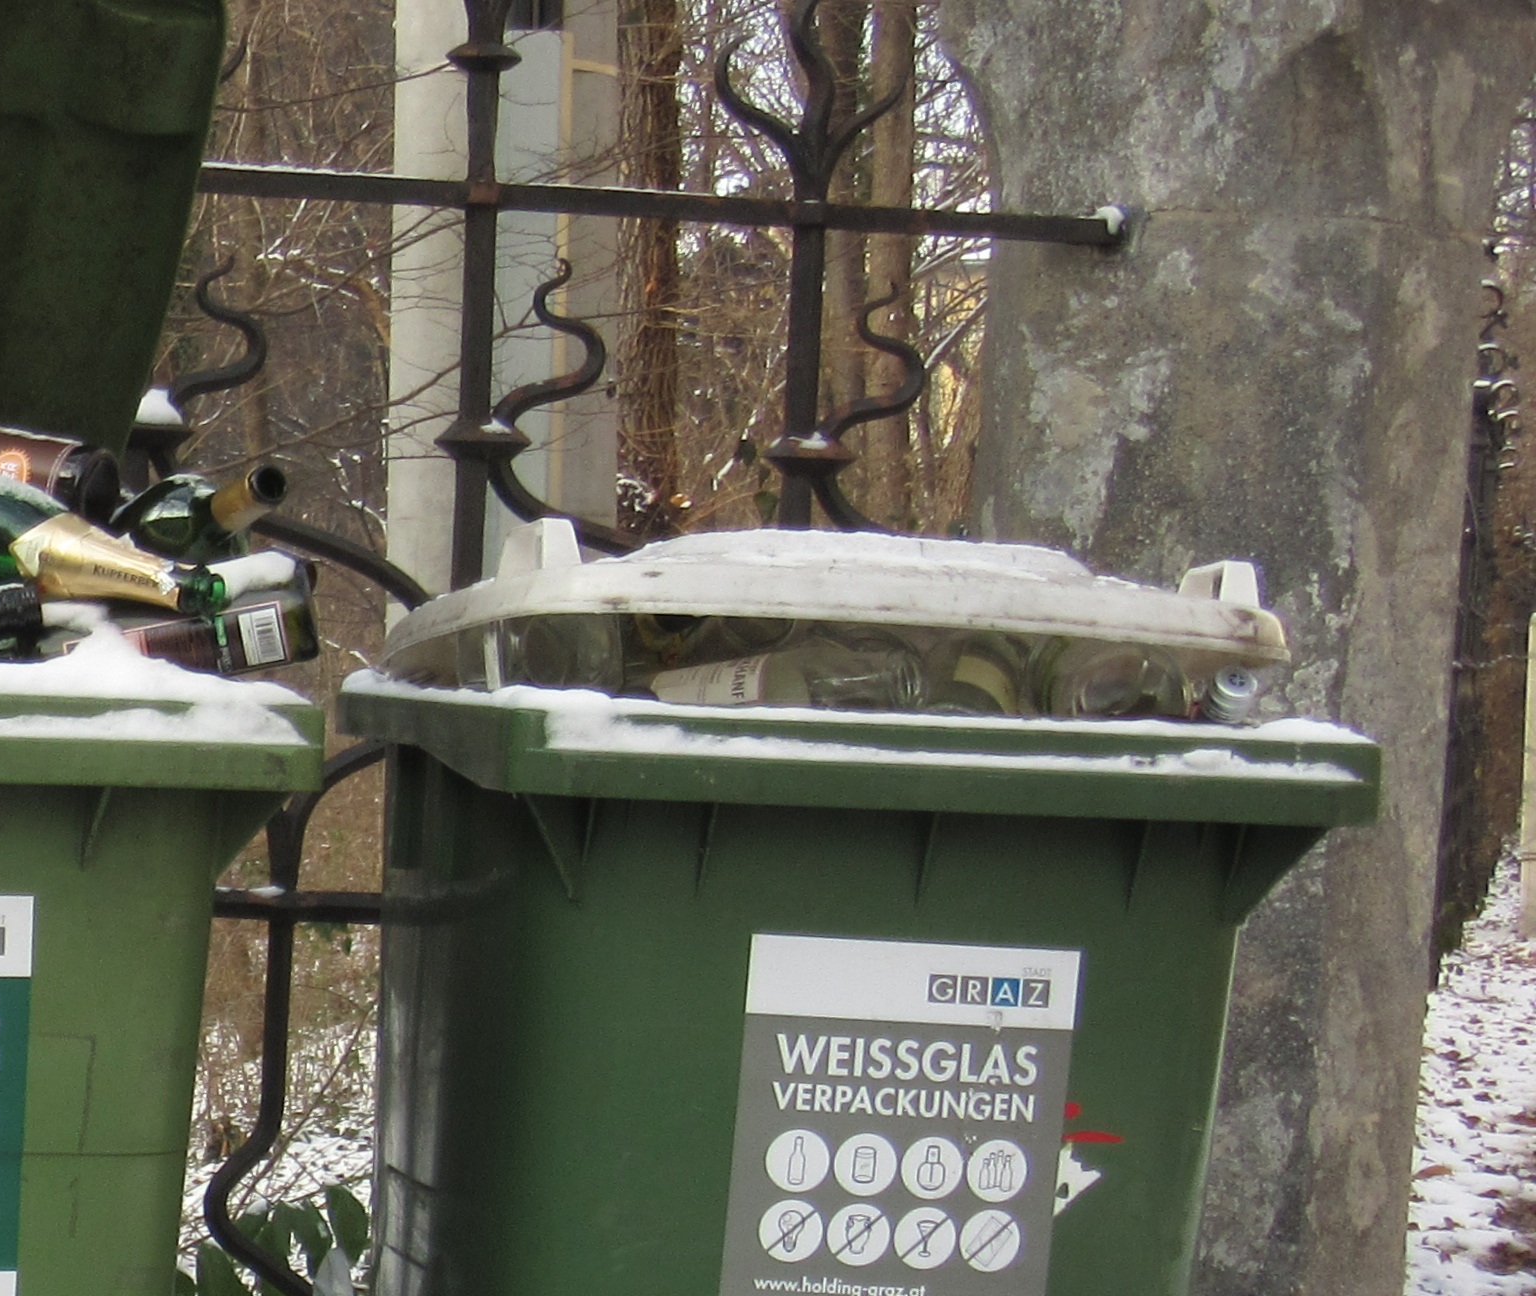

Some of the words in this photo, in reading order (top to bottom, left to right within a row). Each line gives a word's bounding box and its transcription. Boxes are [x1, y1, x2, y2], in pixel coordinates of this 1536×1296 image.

[1022, 967, 1051, 977] STADT
[929, 975, 1049, 1007] GRAZ
[777, 1033, 1039, 1086] WEISSGLAS
[772, 1082, 1035, 1123] VERPACKUNGEN
